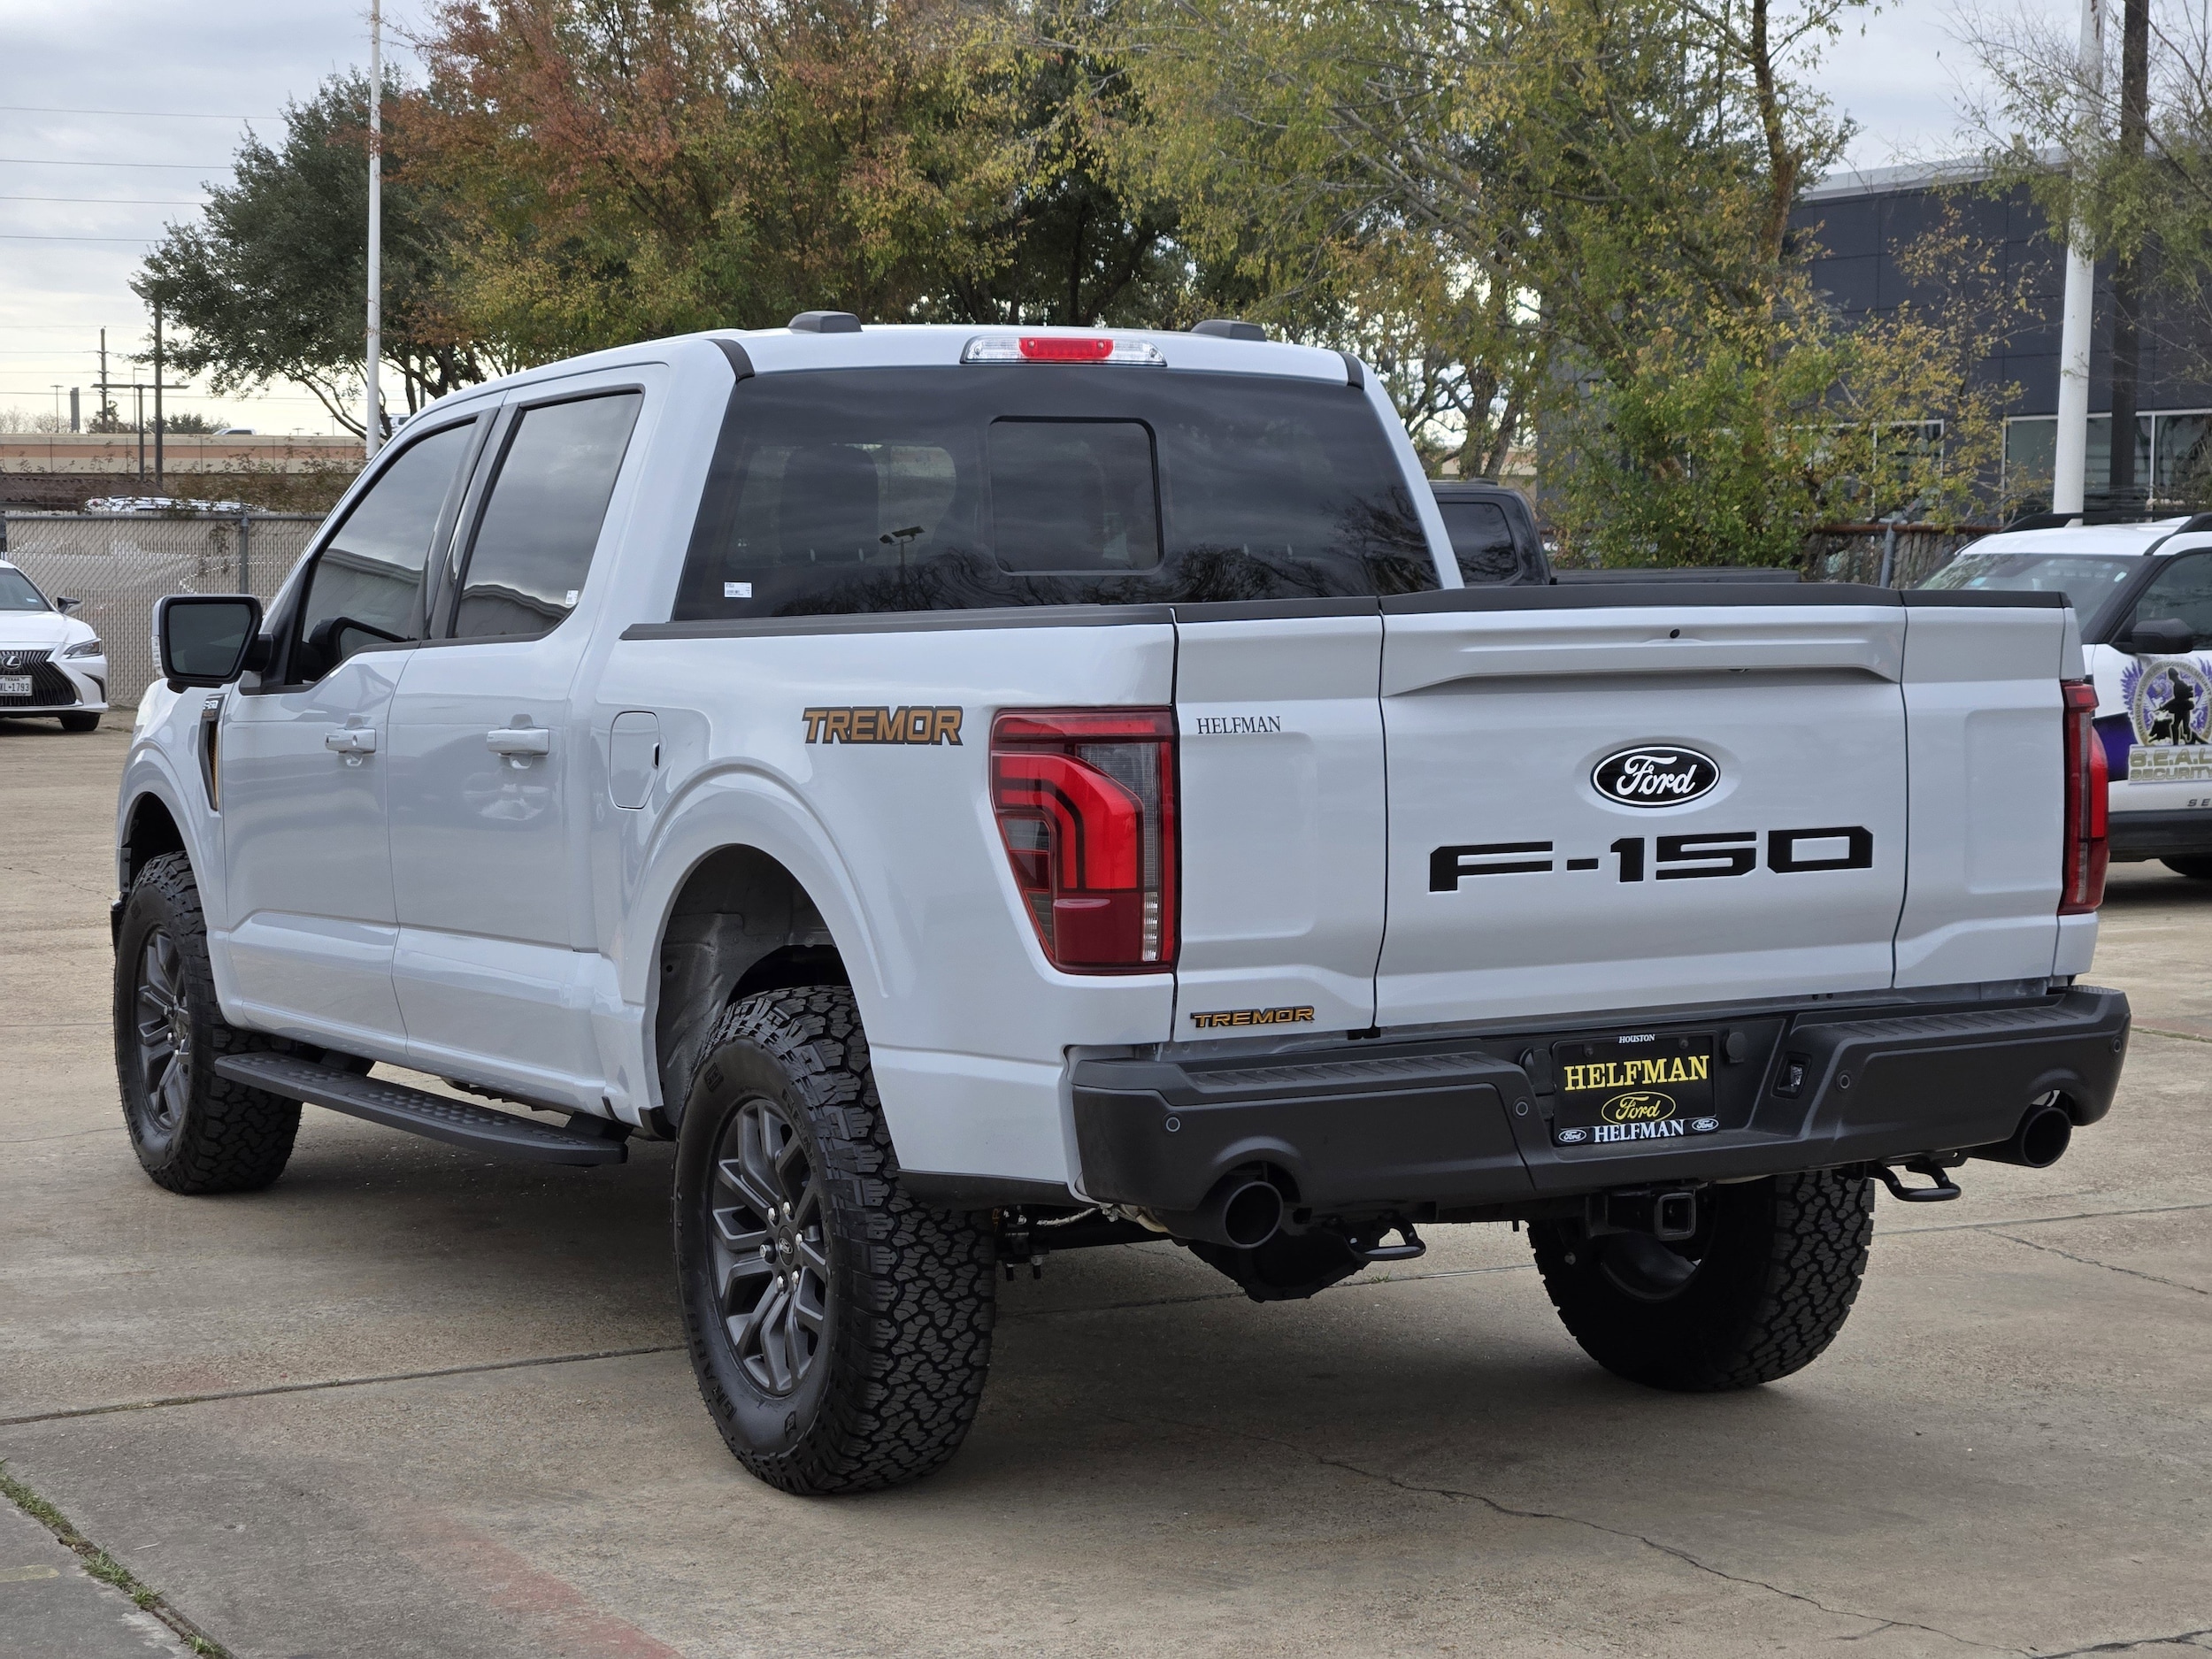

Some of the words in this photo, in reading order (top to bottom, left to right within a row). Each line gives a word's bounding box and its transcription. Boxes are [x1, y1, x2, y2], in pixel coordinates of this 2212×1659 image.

[802, 706, 963, 746] TREMOR
[1196, 716, 1281, 734] HELFMAN
[1616, 754, 1699, 795] Ford
[1429, 826, 1874, 892] F-150
[1190, 1005, 1315, 1028] TREMOR
[1618, 1033, 1655, 1044] HOUSTON
[1563, 1055, 1709, 1091] HELFMAN
[1616, 1095, 1661, 1120] Ford
[1594, 1119, 1685, 1143] HELFMAN
